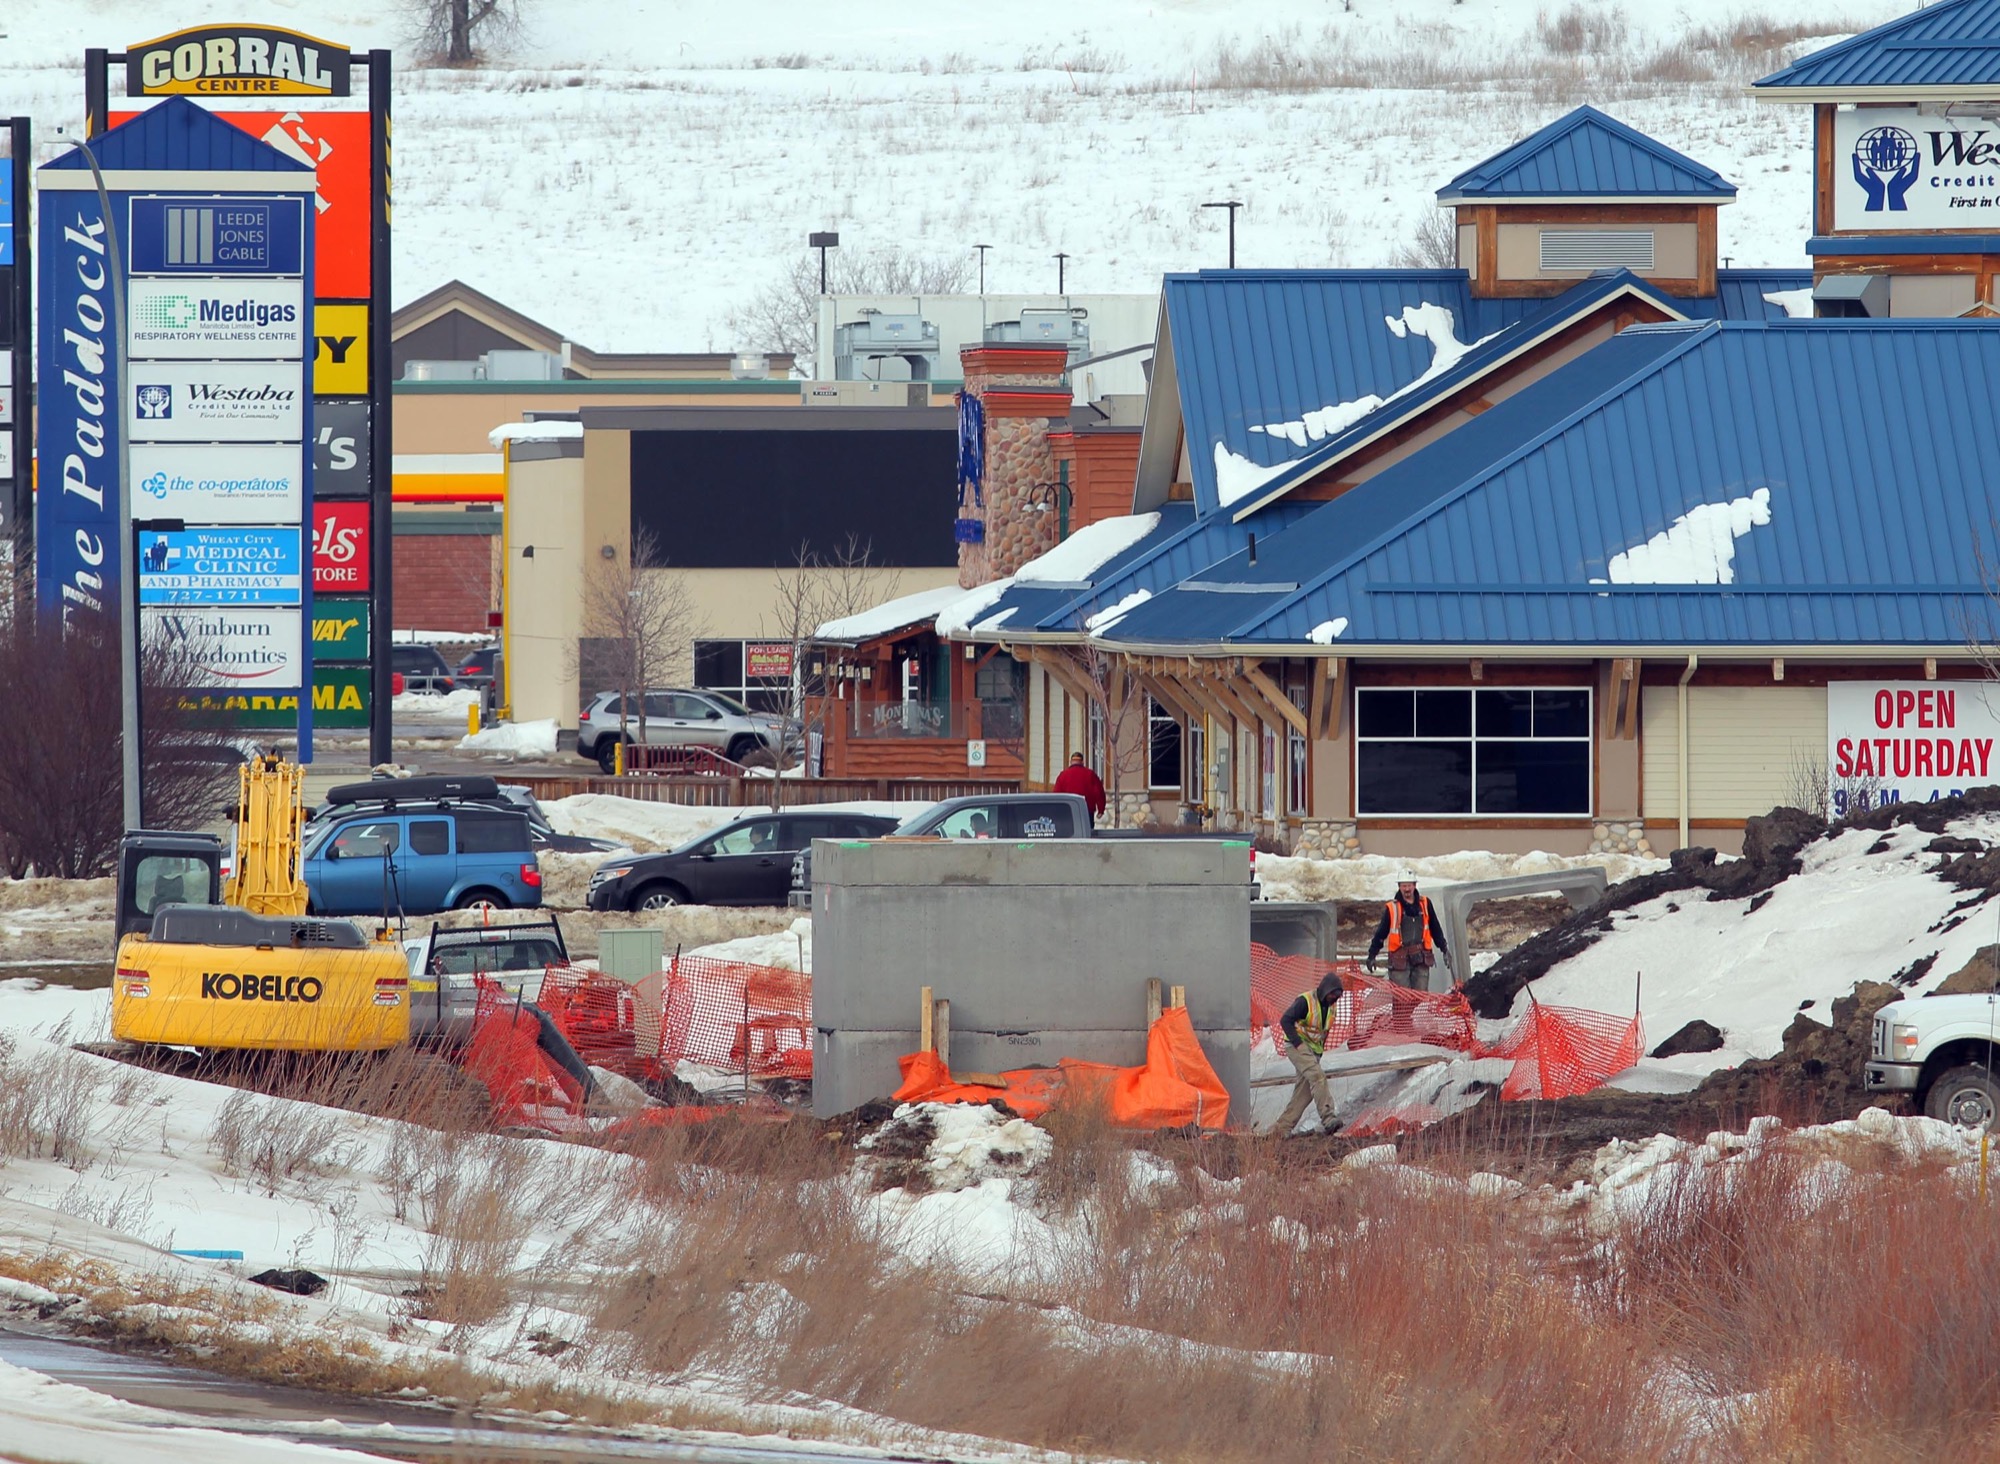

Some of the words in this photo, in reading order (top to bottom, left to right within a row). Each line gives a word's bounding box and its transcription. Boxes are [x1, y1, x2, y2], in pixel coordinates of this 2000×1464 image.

[142, 36, 332, 88] CORRAL
[195, 79, 280, 91] CENTRE
[1930, 174, 1994, 188] Credit
[1949, 196, 1977, 208] First
[1980, 196, 1992, 208] in
[218, 213, 264, 226] LEEDE
[219, 230, 264, 245] JONES
[218, 247, 264, 260] GABLE
[199, 299, 296, 326] Medigas
[199, 322, 230, 330] Manitoba
[231, 322, 255, 330] Limited
[134, 332, 201, 340] RESPIRATORY
[204, 332, 256, 340] WELLNESS
[259, 332, 297, 341] CENTRE
[314, 336, 358, 363] Y
[63, 211, 105, 512] Paddock
[186, 384, 295, 401] Westoba
[272, 403, 291, 411] Ltd
[313, 427, 358, 470] 's
[170, 476, 194, 491] the
[198, 477, 289, 493] co-operators
[198, 535, 241, 544] WHEAT
[244, 534, 274, 544] CITY
[185, 545, 287, 560] MEDICAL
[193, 559, 278, 573] CLINIC
[62, 529, 104, 648] he
[146, 576, 182, 587] AND
[187, 575, 283, 587] PHARMACY
[168, 590, 261, 600] 727-1711
[157, 615, 271, 641] Winburn
[1874, 689, 1955, 729] OPEN
[1835, 738, 1994, 778] SATURDAY
[201, 972, 323, 1003] KOBELCO
